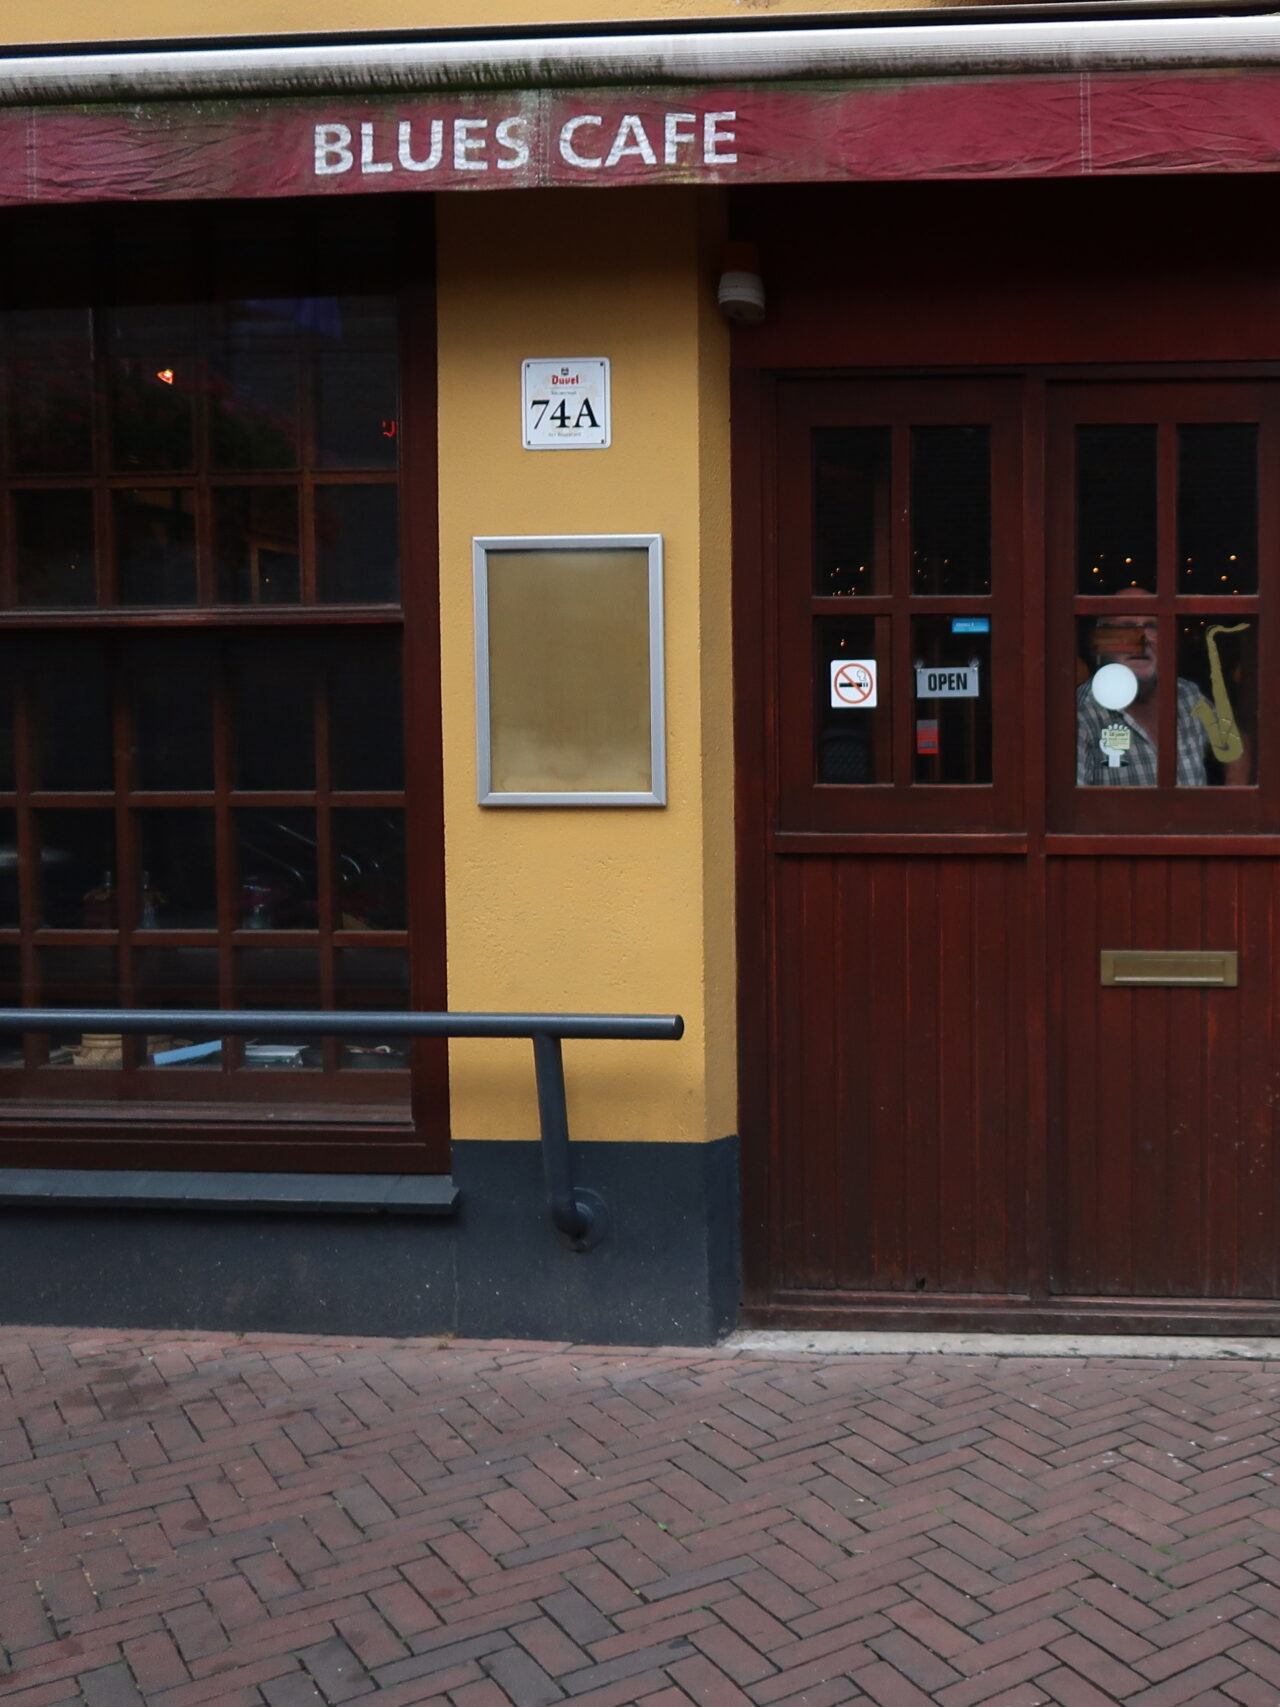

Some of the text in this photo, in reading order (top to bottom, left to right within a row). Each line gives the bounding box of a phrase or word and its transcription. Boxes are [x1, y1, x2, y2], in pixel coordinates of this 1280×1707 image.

[314, 111, 738, 175] BLUES CAFE
[551, 374, 579, 385] Duvel
[530, 397, 601, 430] 74A
[927, 673, 968, 691] OPEN
